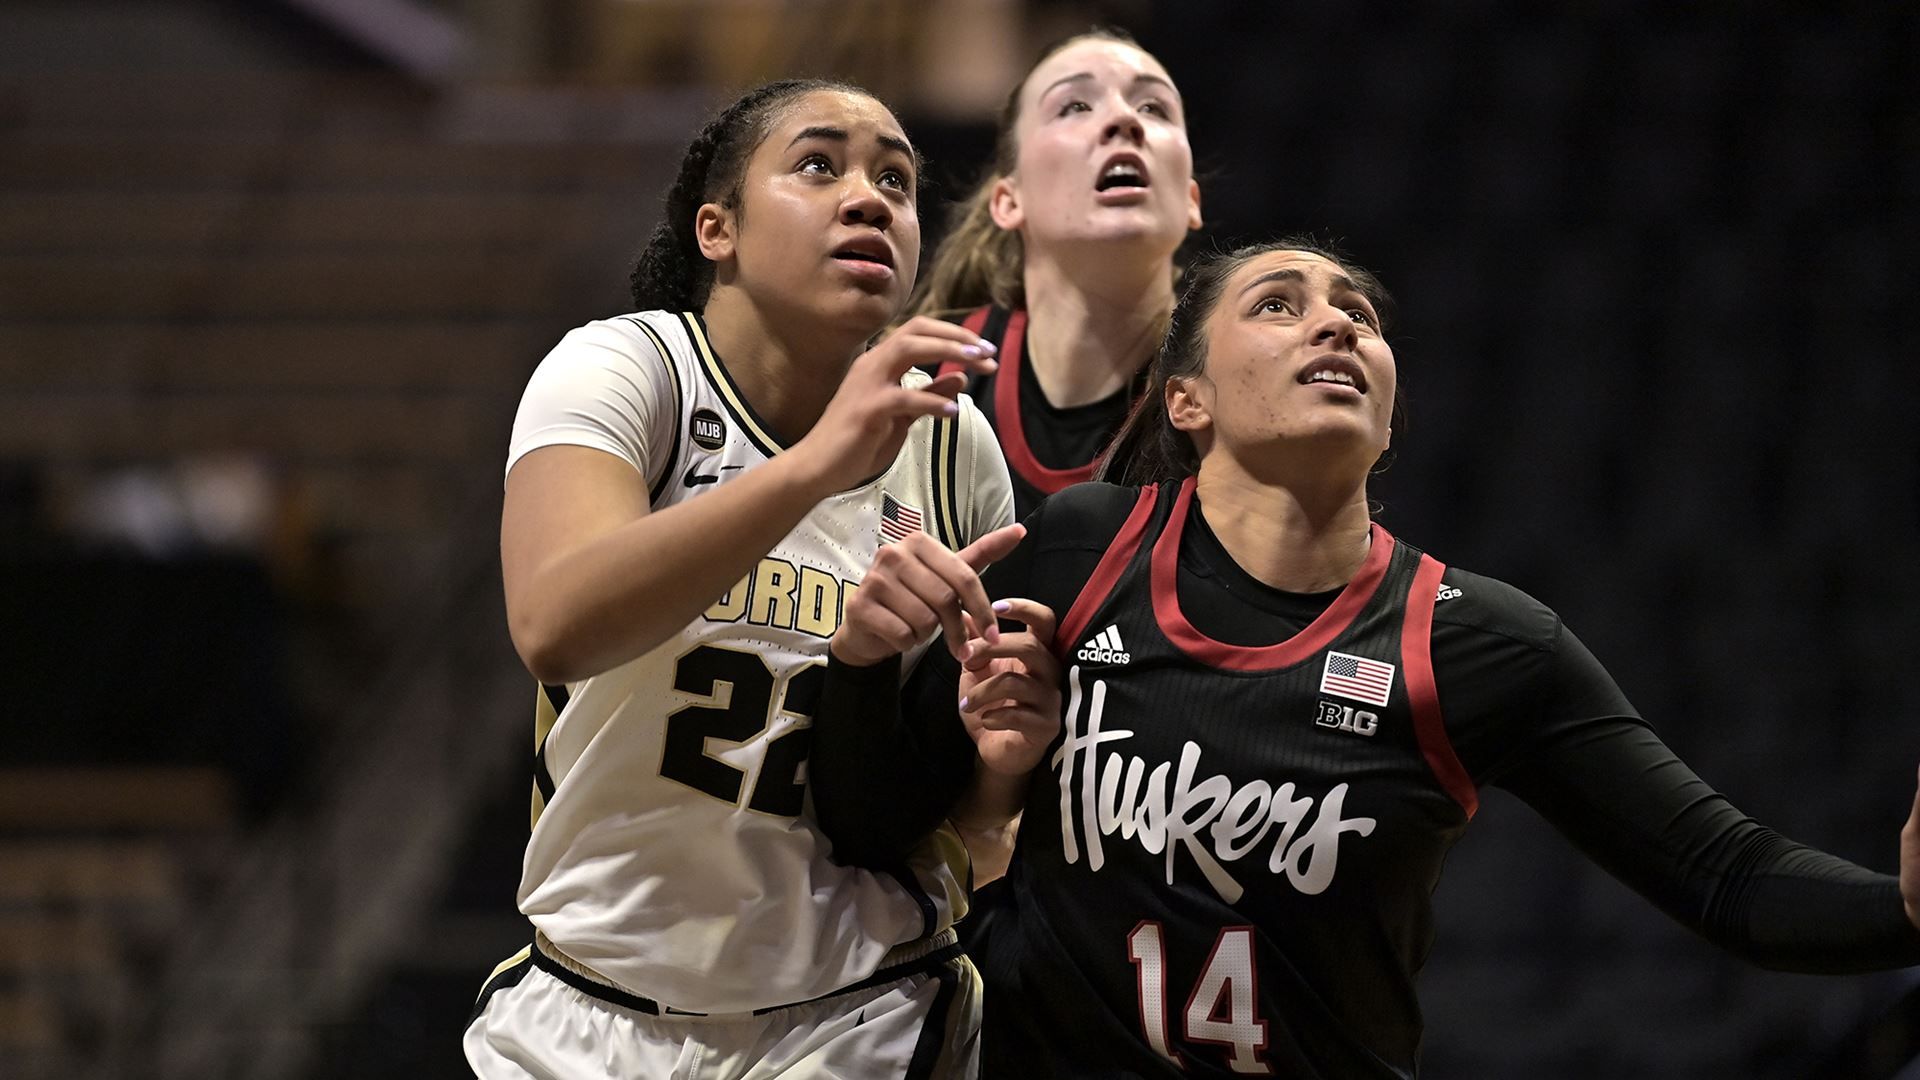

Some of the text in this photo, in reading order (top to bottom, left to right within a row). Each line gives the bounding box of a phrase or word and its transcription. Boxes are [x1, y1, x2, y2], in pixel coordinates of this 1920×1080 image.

[696, 420, 721, 439] MJB
[702, 556, 860, 639] URD
[1078, 647, 1131, 664] adidas
[657, 642, 829, 818] 22
[1051, 665, 1376, 905] Huskers
[1127, 919, 1275, 1077] 14
